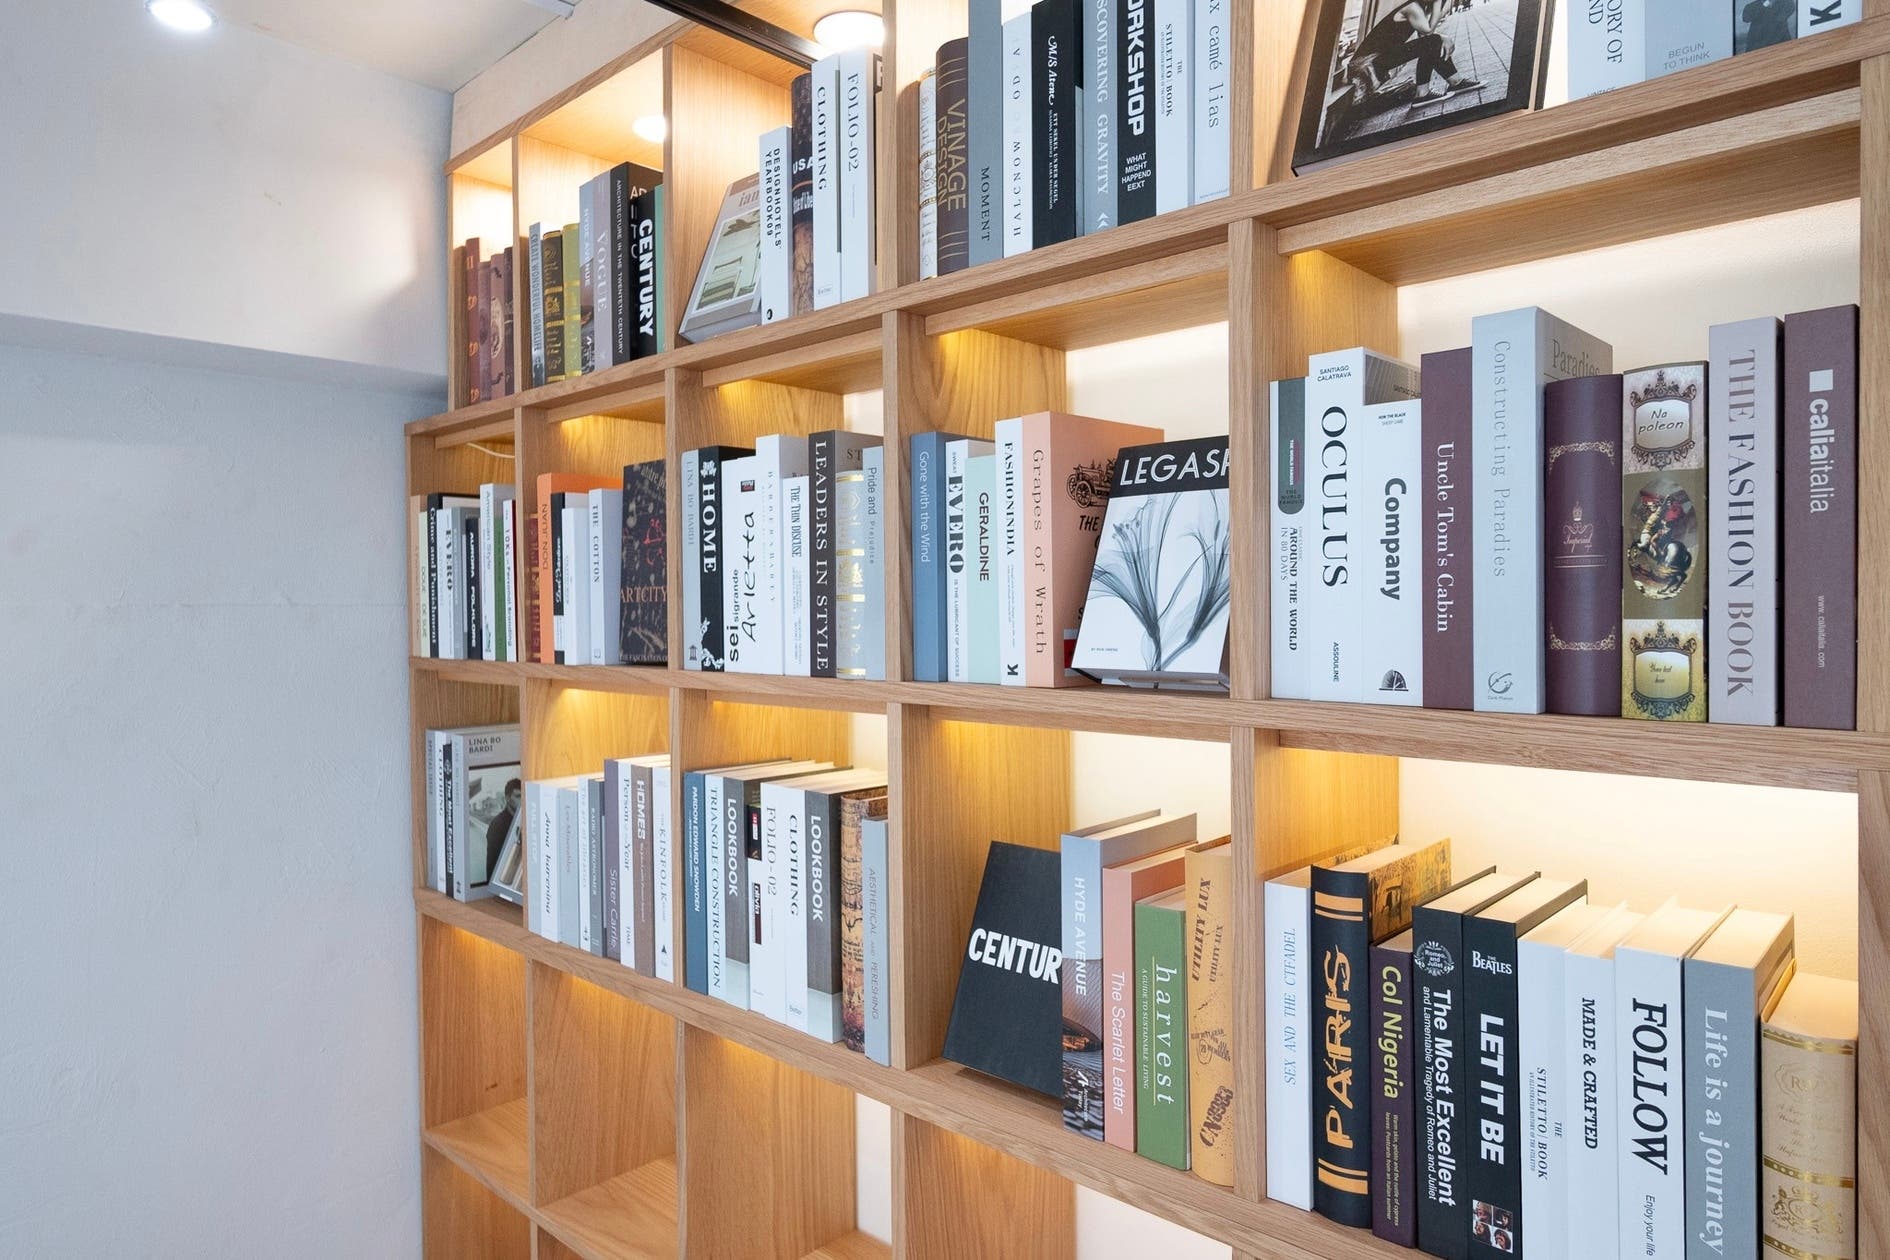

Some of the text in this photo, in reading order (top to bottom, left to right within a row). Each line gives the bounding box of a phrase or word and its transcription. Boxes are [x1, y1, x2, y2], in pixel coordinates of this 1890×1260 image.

[1663, 51, 1711, 71] TO THINK
[1668, 42, 1705, 59] BEGUN
[792, 156, 813, 175] USA
[816, 86, 827, 190] CLOTHING
[847, 73, 860, 172] FOLIO-02
[935, 116, 949, 207] DESIGN
[947, 98, 967, 211] VINAGE
[1125, 161, 1147, 174] MIGHT
[1126, 152, 1147, 164] WHAT
[981, 166, 990, 241] MOMENT
[1121, 169, 1152, 184] HAPPEND
[1127, 180, 1145, 192] EEXT
[597, 231, 608, 313] VOGUE
[616, 242, 622, 251] IN
[639, 218, 654, 337] CENTURY
[1317, 371, 1352, 382] CALATRAVA
[1319, 365, 1350, 376] SANTIAGO
[1650, 407, 1668, 420] Na
[1491, 341, 1512, 578] Constructing Paradies
[1638, 419, 1684, 434] poleon
[1809, 398, 1835, 513] caliaitalia
[868, 467, 877, 494] Pride
[868, 495, 876, 515] and
[919, 451, 931, 563] Gone with the Wind
[1079, 515, 1099, 531] THE
[1321, 405, 1348, 587] OCULUS
[1726, 348, 1756, 697] THE FASHION BOOK
[702, 482, 717, 574] HOME
[815, 440, 828, 670] LEADERS IN STYLE
[979, 492, 990, 582] GERALDINE
[1032, 449, 1047, 654] Grapes of Wrath
[1280, 527, 1288, 581] IN 80 DAYS
[1380, 477, 1407, 601] Company
[1437, 440, 1455, 633] Uncle Tom's Cabin
[1289, 527, 1298, 651] AROUND THE WORLD
[726, 624, 739, 662] sei
[468, 738, 488, 747] LINA
[637, 779, 646, 840] HOMES
[727, 797, 738, 898] LOOKBOOK
[766, 806, 777, 897] FOLIO-02
[609, 869, 618, 948] Sister Carrie
[709, 787, 720, 988] TRIANGLE CONSTRUCTION
[788, 814, 799, 916] CLOTHING
[811, 815, 823, 922] LOOKBOOK
[868, 868, 877, 934] AESTHETICAL
[968, 928, 1063, 985] CENTUR
[1074, 876, 1087, 997] HYDE AVENUE
[1191, 877, 1211, 982] UTILITY LUX
[1208, 924, 1224, 984] UTILITY LUX
[1472, 950, 1512, 975] BEATLES
[1111, 971, 1126, 1114] The Scarlet Letter
[1142, 1000, 1147, 1011] TO
[1155, 963, 1177, 1106] harvest
[1323, 943, 1353, 1149] PARIS
[1379, 965, 1402, 1100] Col Nigeria
[1422, 986, 1437, 1200] and Lamentable Tragedy of Romeo and Juliet
[1433, 988, 1455, 1206] The Most Excellent
[1480, 1012, 1504, 1165] LET IT BE
[1582, 998, 1599, 1150] MADE & CRAFTED
[1632, 997, 1668, 1175] FOLLOW
[1537, 1067, 1548, 1180] STILETTO BOOK
[1554, 1121, 1562, 1138] THE
[1699, 1006, 1730, 1256] Life is a journey
[1644, 1194, 1656, 1256] Enjoy your life
